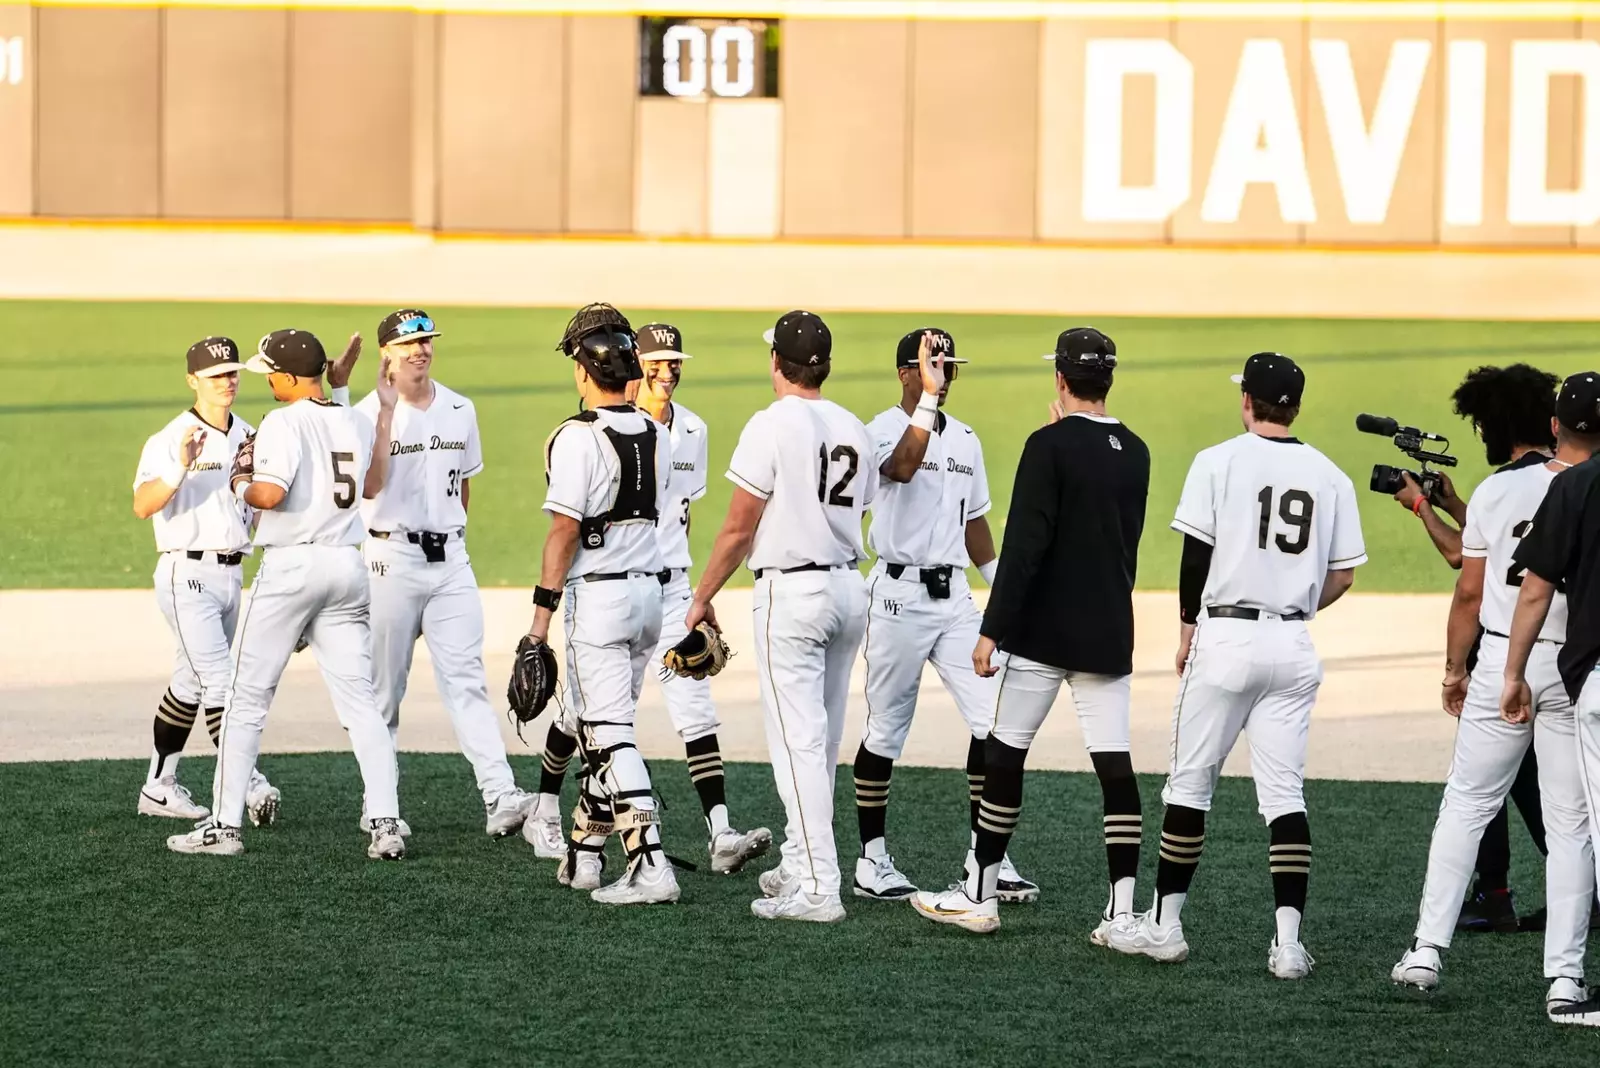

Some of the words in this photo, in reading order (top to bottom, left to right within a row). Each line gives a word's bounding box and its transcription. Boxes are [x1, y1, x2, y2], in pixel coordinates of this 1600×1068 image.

[662, 25, 755, 97] 00
[1081, 38, 1600, 226] DAVID
[652, 330, 675, 346] WF
[207, 343, 231, 360] WF
[390, 440, 424, 456] Demon
[817, 442, 860, 508] 12
[920, 461, 940, 472] mon
[330, 452, 357, 509] 5
[1257, 486, 1313, 555] 19
[371, 561, 389, 576] WF
[187, 579, 205, 593] WF
[883, 599, 902, 616] WF
